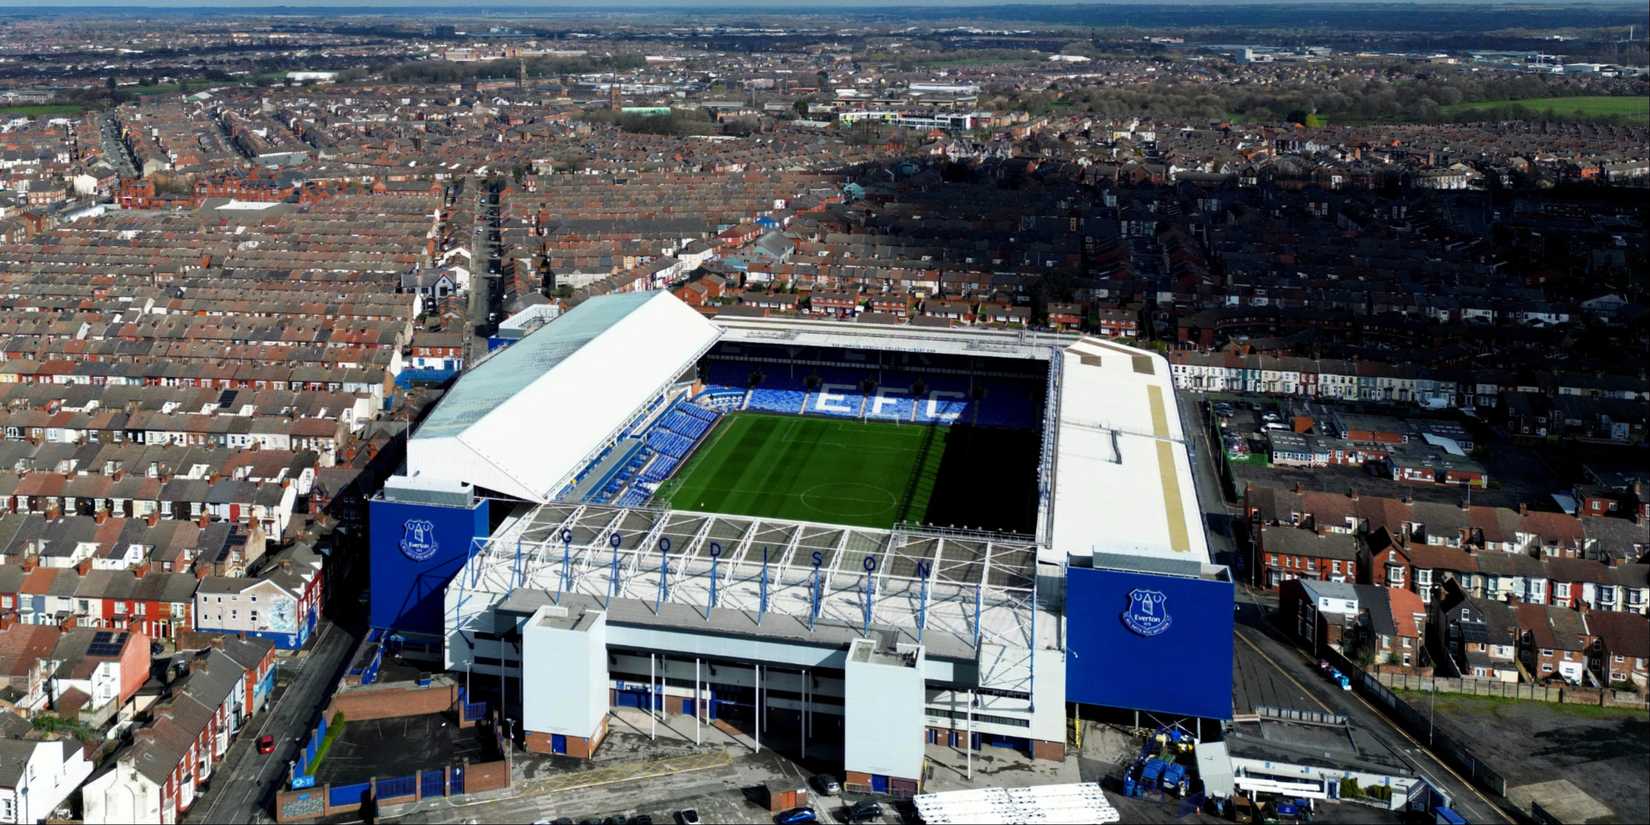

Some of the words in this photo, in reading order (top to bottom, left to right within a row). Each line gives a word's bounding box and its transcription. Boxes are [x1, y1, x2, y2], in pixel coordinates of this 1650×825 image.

[815, 383, 967, 419] EFC
[562, 529, 929, 577] GOODISON
[1134, 614, 1161, 623] Everton
